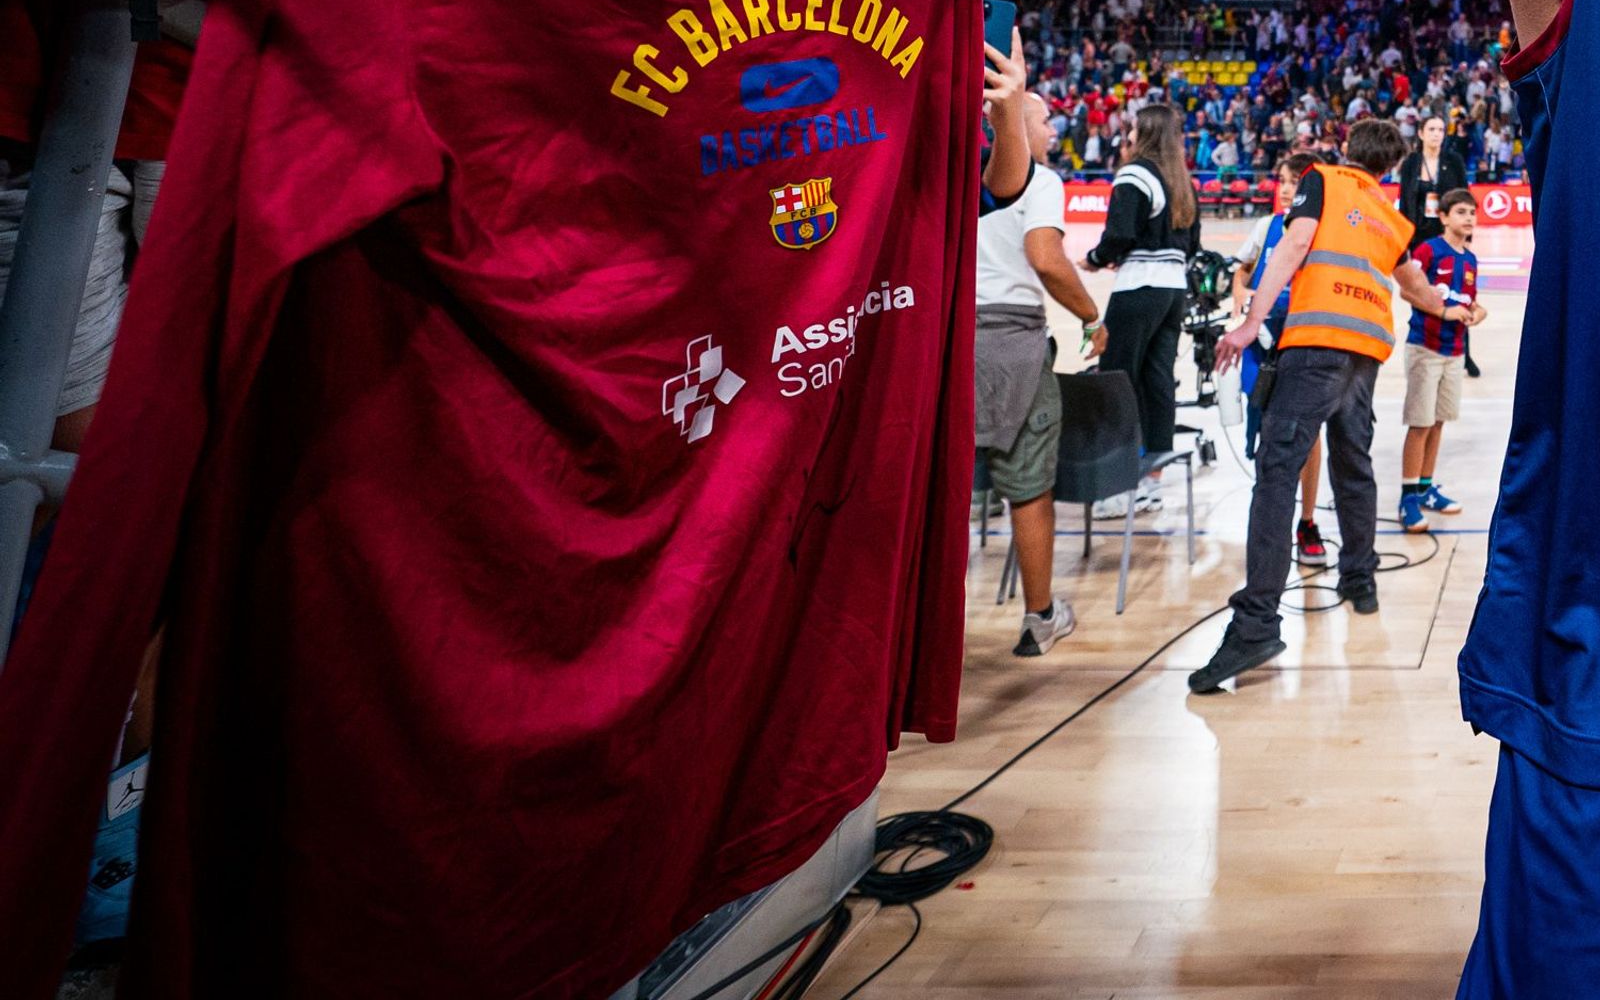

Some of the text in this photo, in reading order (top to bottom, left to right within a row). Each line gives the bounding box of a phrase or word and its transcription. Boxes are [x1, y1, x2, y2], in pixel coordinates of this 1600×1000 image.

[610, 44, 689, 117] FC
[700, 105, 888, 177] BASKETBALL
[791, 208, 817, 221] FCB
[1067, 195, 1108, 212] AIRL
